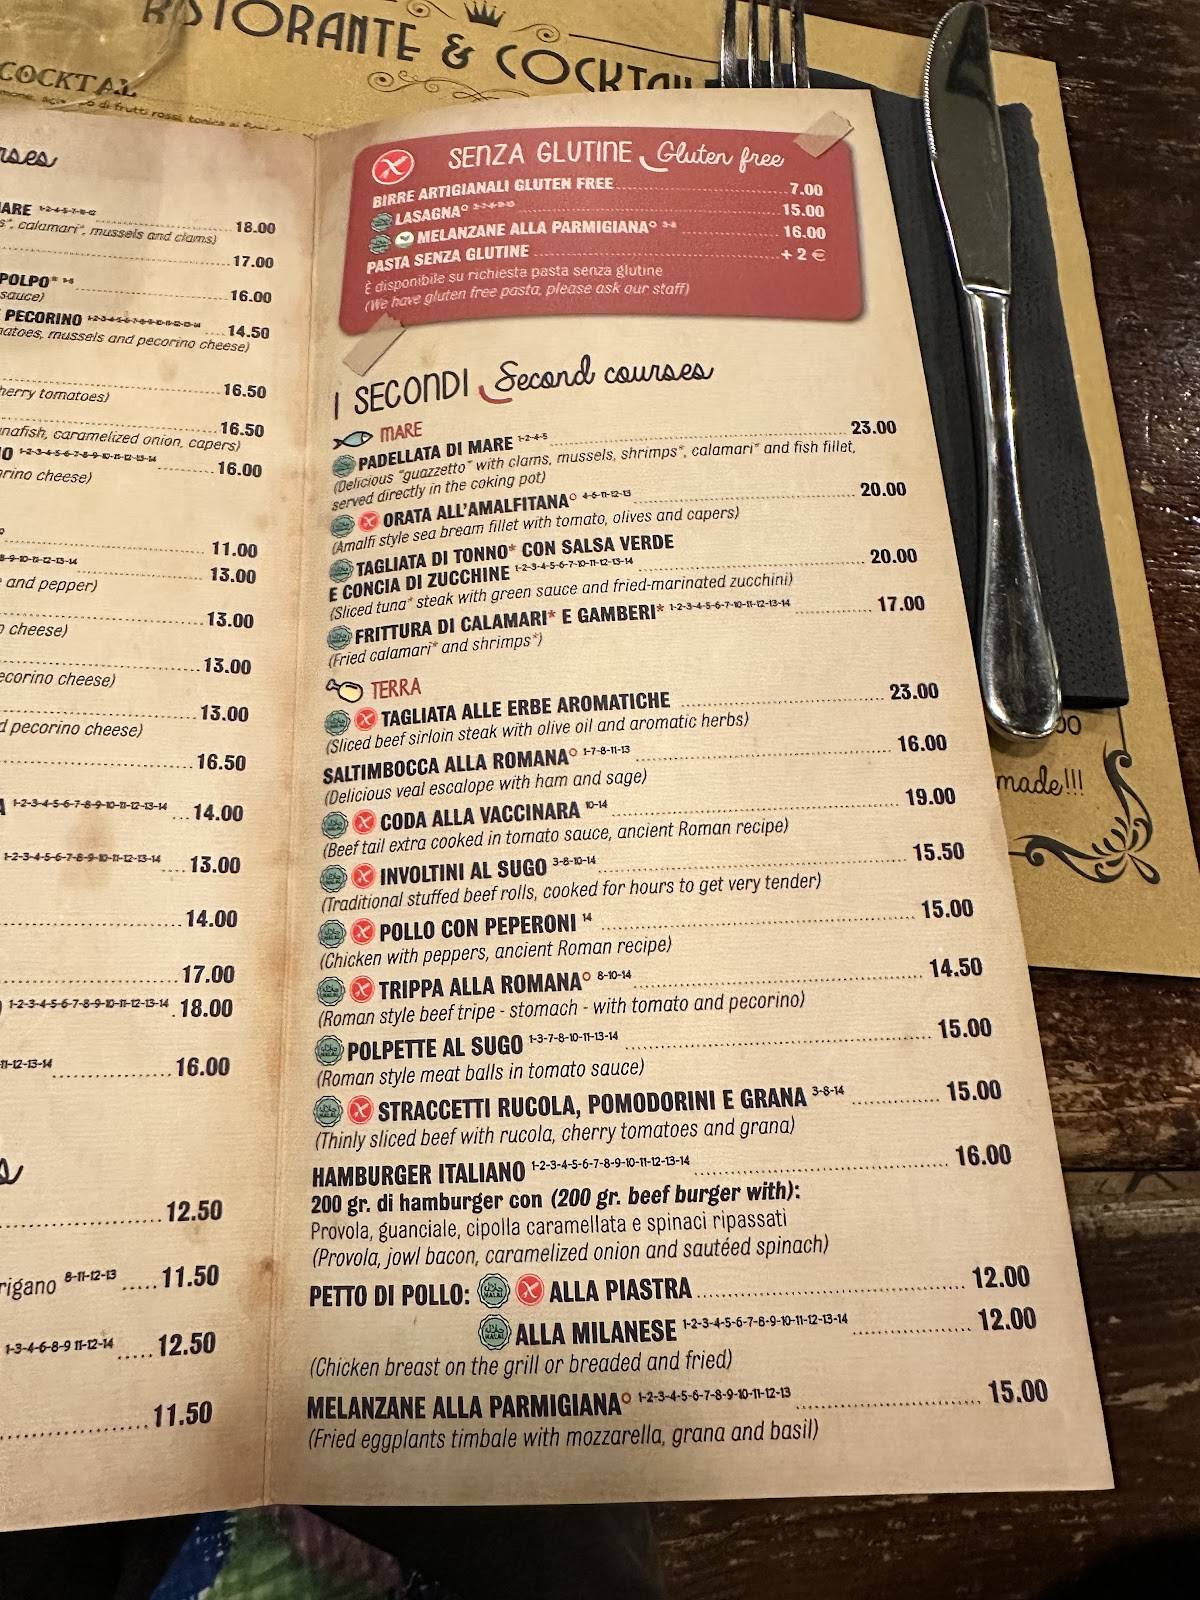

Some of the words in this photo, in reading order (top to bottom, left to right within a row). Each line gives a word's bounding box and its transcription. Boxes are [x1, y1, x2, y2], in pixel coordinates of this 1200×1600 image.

[142, 0, 421, 62] RSTORANTE
[441, 33, 475, 70] &
[448, 142, 525, 170] SENZA
[537, 140, 633, 163] GLUTINE
[657, 140, 734, 166] Gluten
[739, 147, 784, 173] free
[372, 190, 415, 209] BIRRE
[418, 179, 509, 200] ARTIGIANALI
[514, 177, 572, 192] GLUTEN
[576, 177, 614, 190] FREE
[789, 182, 823, 197] 7.00
[783, 203, 825, 217] 15.00
[90, 226, 144, 240] mussels
[147, 230, 172, 242] and
[236, 221, 276, 234] 18.00
[417, 222, 505, 244] MELANZANE
[509, 221, 547, 236] ALLA
[783, 225, 826, 240] 16.00
[366, 257, 410, 275] PASTA
[414, 249, 462, 267] SENZA
[466, 244, 530, 261] GLUTINE
[375, 273, 445, 294] disponibile
[449, 272, 464, 283] su
[468, 266, 527, 281] richiesta
[531, 266, 569, 280] pasta
[573, 266, 612, 277] senza
[616, 264, 663, 279] glutine
[391, 293, 421, 309] have
[425, 287, 466, 306] gluten
[470, 284, 497, 299] free
[546, 282, 592, 298] please
[596, 282, 621, 296] ask
[624, 284, 649, 295] our
[652, 282, 690, 297] staff)
[5, 308, 82, 326] PECORINO
[228, 325, 270, 340] 14.50
[48, 330, 105, 344] mussels
[108, 333, 134, 345] and
[136, 335, 196, 350] pecorino
[199, 338, 250, 353] cheese)
[39, 387, 110, 403] tomatoes)
[224, 383, 267, 399] 16.50
[333, 391, 339, 421] I
[354, 367, 469, 416] SECONDI
[494, 354, 596, 393] Second
[603, 361, 715, 384] courses
[380, 421, 423, 443] MARE
[358, 446, 441, 472] PADELLATA
[446, 441, 463, 457] DI
[468, 436, 513, 454] MARE
[851, 420, 897, 435] 23.00
[218, 461, 263, 478] 16.00
[331, 493, 373, 512] served
[377, 484, 425, 504] directly
[429, 483, 441, 494] in
[445, 479, 466, 493] the
[470, 472, 515, 491] coking
[518, 470, 546, 488] pot)
[860, 481, 907, 497] 20.00
[212, 541, 258, 558] 11.00
[6, 575, 36, 590] and
[38, 577, 98, 594] pepper)
[207, 611, 254, 629] 13.00
[355, 621, 432, 645] FRITTURA
[438, 618, 455, 634] DI
[562, 608, 572, 624] E
[878, 595, 925, 612] 17.00
[371, 676, 422, 699] TERRA
[381, 705, 457, 727] TAGLIATA
[461, 701, 502, 720] ALLE
[507, 698, 552, 717] ERBE
[557, 691, 671, 713] AROMATICHE
[889, 682, 940, 700] 23.00
[10, 719, 80, 736] pecorino
[84, 723, 143, 739] cheese)
[897, 734, 947, 752] 16.00
[197, 754, 247, 772] 16.50
[380, 810, 427, 832] CODA
[432, 808, 474, 828] ALLA
[480, 801, 581, 825] VACCINARA
[905, 787, 956, 806] 19.00
[322, 838, 360, 860] (Beef
[362, 837, 385, 855] tail
[389, 835, 426, 853] extra
[431, 833, 483, 852] cooked
[487, 831, 500, 847] in
[505, 828, 560, 845] tomato
[564, 827, 612, 843] sauce,
[617, 821, 674, 840] ancient
[678, 819, 731, 837] Roman
[736, 817, 789, 837] recipe)
[913, 842, 965, 861] 15.50
[190, 856, 241, 874] 13.00
[380, 919, 435, 942] POLLO
[441, 917, 478, 938] CON
[485, 913, 577, 936] PEPERONI
[922, 899, 974, 919] 15.00
[183, 965, 235, 984] 17.00
[938, 1017, 992, 1039] 15.00
[176, 1057, 230, 1077] 16.00
[378, 1097, 491, 1123] STRACCETTI
[498, 1094, 581, 1120] RUCOLA,
[588, 1090, 716, 1115] POMODORINI
[723, 1089, 734, 1110] E
[741, 1087, 808, 1110] GRANA
[946, 1079, 1002, 1101] 15.00
[312, 1163, 432, 1188] HAMBURGER
[439, 1160, 526, 1185] ITALIANO
[955, 1143, 1012, 1166] 16.00
[166, 1199, 223, 1222] 12.50
[311, 1221, 373, 1242] Provola,
[378, 1218, 461, 1242] guanciale,
[466, 1216, 520, 1241] cipolla
[526, 1214, 626, 1235] caramellata
[632, 1219, 642, 1233] e
[647, 1211, 707, 1238] spinaci
[712, 1208, 788, 1233] ripassati
[162, 1264, 220, 1288] 11.50
[310, 1284, 367, 1307] PETTO
[374, 1284, 395, 1306] DI
[402, 1283, 470, 1306] POLLO:
[550, 1279, 599, 1303] ALLA
[606, 1276, 693, 1301] PIASTRA
[972, 1265, 1031, 1289] 12.00
[988, 1378, 1049, 1403] 15.00
[153, 1400, 213, 1428] 11.50
[308, 1428, 356, 1450] (Fried
[361, 1428, 446, 1454] eggplants
[451, 1426, 518, 1450] timbale
[523, 1426, 560, 1448] with
[566, 1423, 665, 1449] mozzarella,
[672, 1424, 725, 1448] grana
[731, 1418, 765, 1442] and
[769, 1417, 819, 1442] basil)
